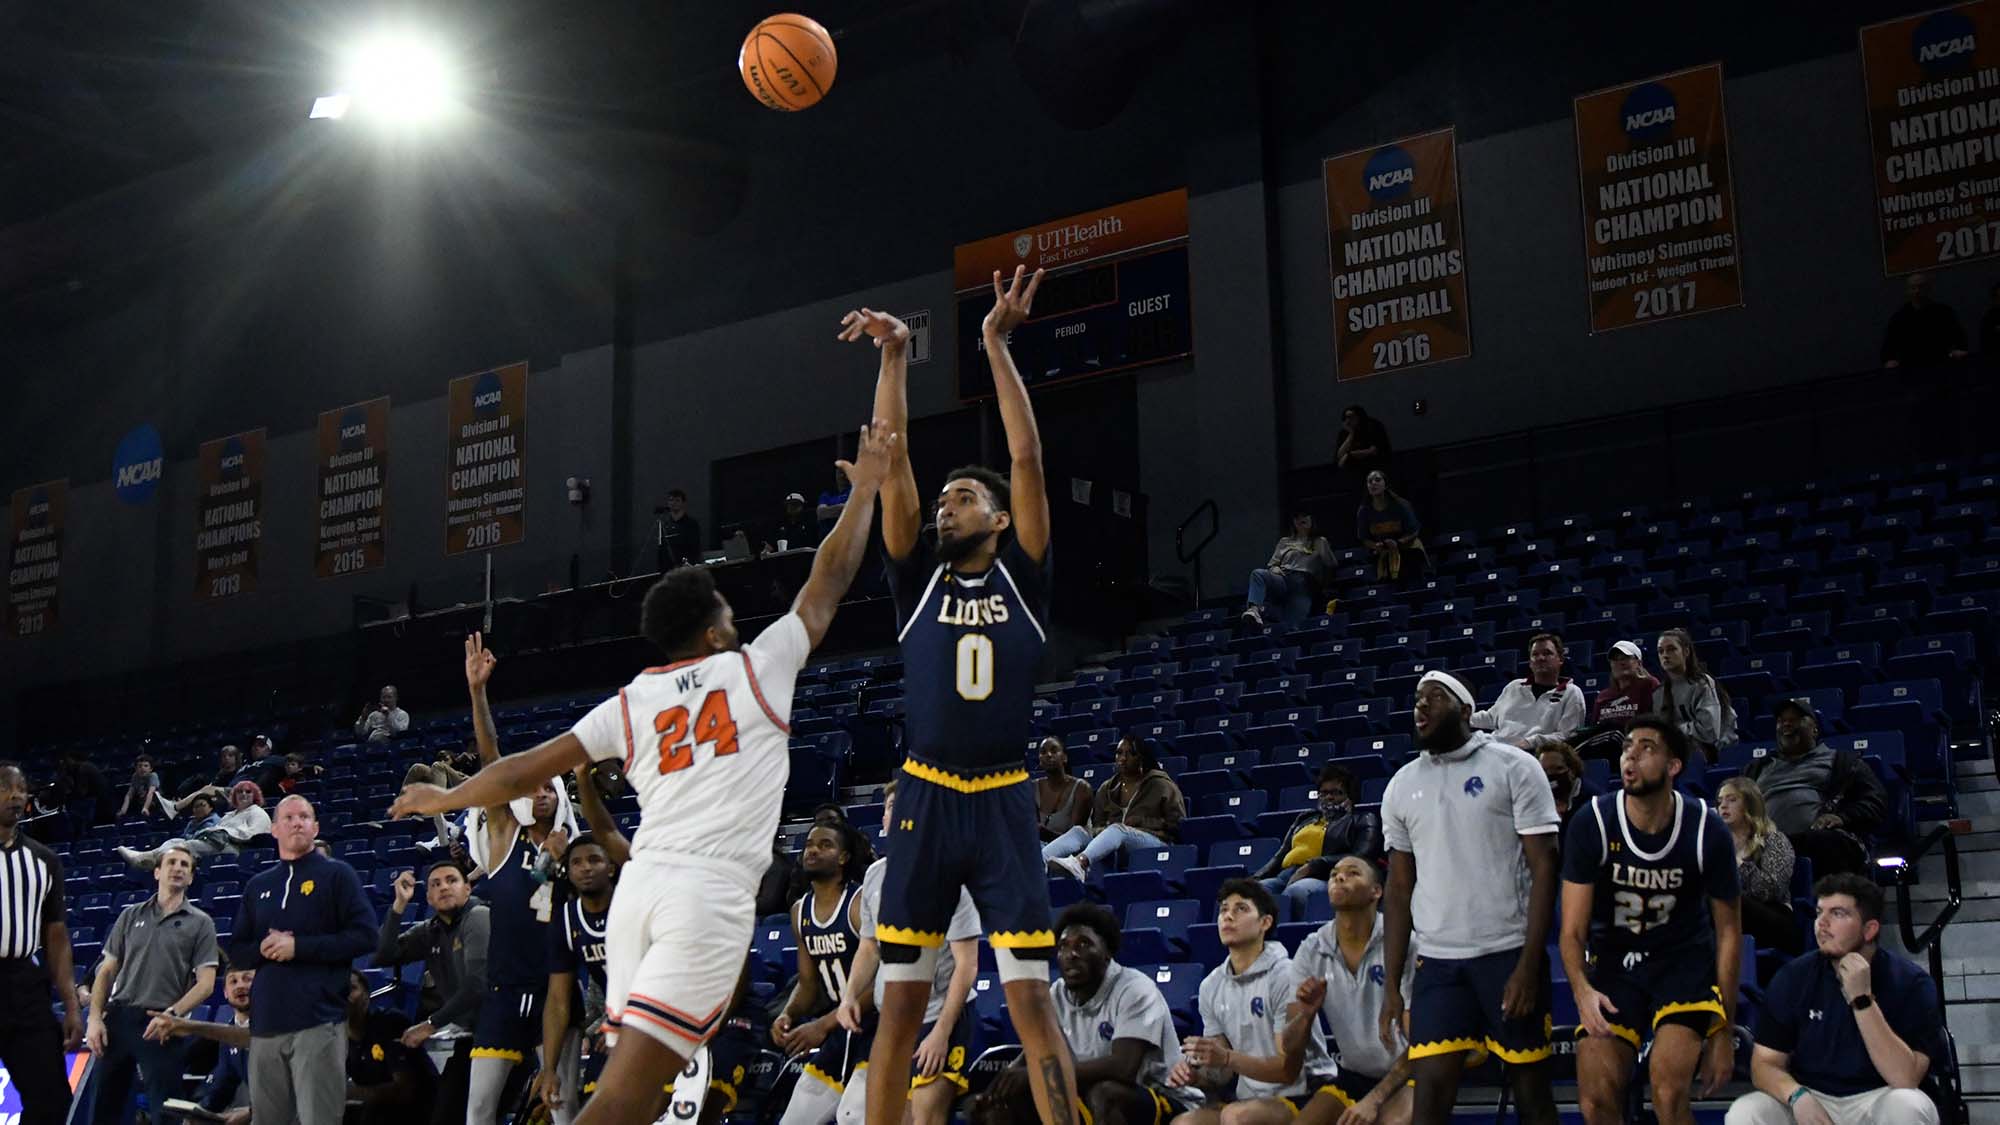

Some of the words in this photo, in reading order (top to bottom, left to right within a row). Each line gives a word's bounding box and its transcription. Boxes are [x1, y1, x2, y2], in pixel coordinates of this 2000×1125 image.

[1919, 34, 1976, 63] NCAA
[1897, 75, 1974, 107] Division
[1977, 67, 2000, 89] III
[1625, 105, 1676, 132] NCAA
[1889, 97, 2000, 148] NATIONA
[1606, 145, 1674, 173] Division
[1677, 137, 1696, 156] III
[1886, 133, 2000, 184] CHAMPI
[1369, 167, 1414, 192] NCAA
[1599, 163, 1713, 212] NATIONAL
[1882, 185, 1955, 214] Whitney
[1958, 175, 2000, 200] Simm
[1352, 204, 1412, 231] Division
[1414, 197, 1431, 215] III
[1594, 194, 1723, 245] CHAMPION
[1885, 212, 1923, 232] Track
[1939, 202, 1974, 221] Field
[1037, 215, 1123, 251] UTHealth
[1344, 221, 1446, 267] NATIONAL
[1936, 220, 2000, 261] 2017
[1039, 251, 1060, 265] East
[1062, 245, 1089, 261] Texas
[1591, 248, 1655, 274] Whitney
[1657, 232, 1733, 261] Simmons
[1333, 249, 1462, 300] CHAMPIONS
[1591, 273, 1629, 293] Indoor
[1656, 260, 1698, 280] Weight
[1699, 253, 1735, 271] Throw
[1128, 294, 1172, 317] GUEST
[1348, 288, 1452, 332] SOFTBALL
[1633, 281, 1696, 320] 2017
[977, 332, 1013, 352] HE
[1055, 322, 1086, 339] PERIOD
[1373, 333, 1431, 370] 2016
[474, 390, 502, 408] NCAA
[341, 423, 366, 440] NCAA
[462, 418, 498, 438] Division
[500, 414, 510, 429] III
[329, 450, 363, 468] Division
[456, 435, 517, 467] NATIONAL
[116, 457, 163, 488] NCAA
[324, 466, 379, 495] NATIONAL
[452, 458, 521, 491] CHAMPION
[204, 499, 255, 527] NATIONAL
[320, 487, 383, 519] CHAMPION
[448, 496, 482, 513] Whitney
[483, 487, 523, 506] Simmons
[197, 520, 261, 550] CHAMPIONS
[467, 521, 501, 548] 2016
[15, 541, 57, 563] NATIONAL
[334, 548, 365, 574] 2015
[212, 574, 240, 597] 2013
[937, 595, 1009, 626] LIONS
[675, 668, 703, 693] WE
[956, 633, 994, 701] 0
[654, 689, 739, 776] 24
[1611, 862, 1684, 890] LIONS
[528, 879, 555, 923] 4
[1612, 890, 1677, 935] 23
[581, 943, 606, 962] LIO
[804, 932, 847, 956] LIONS
[818, 957, 851, 1003] 11
